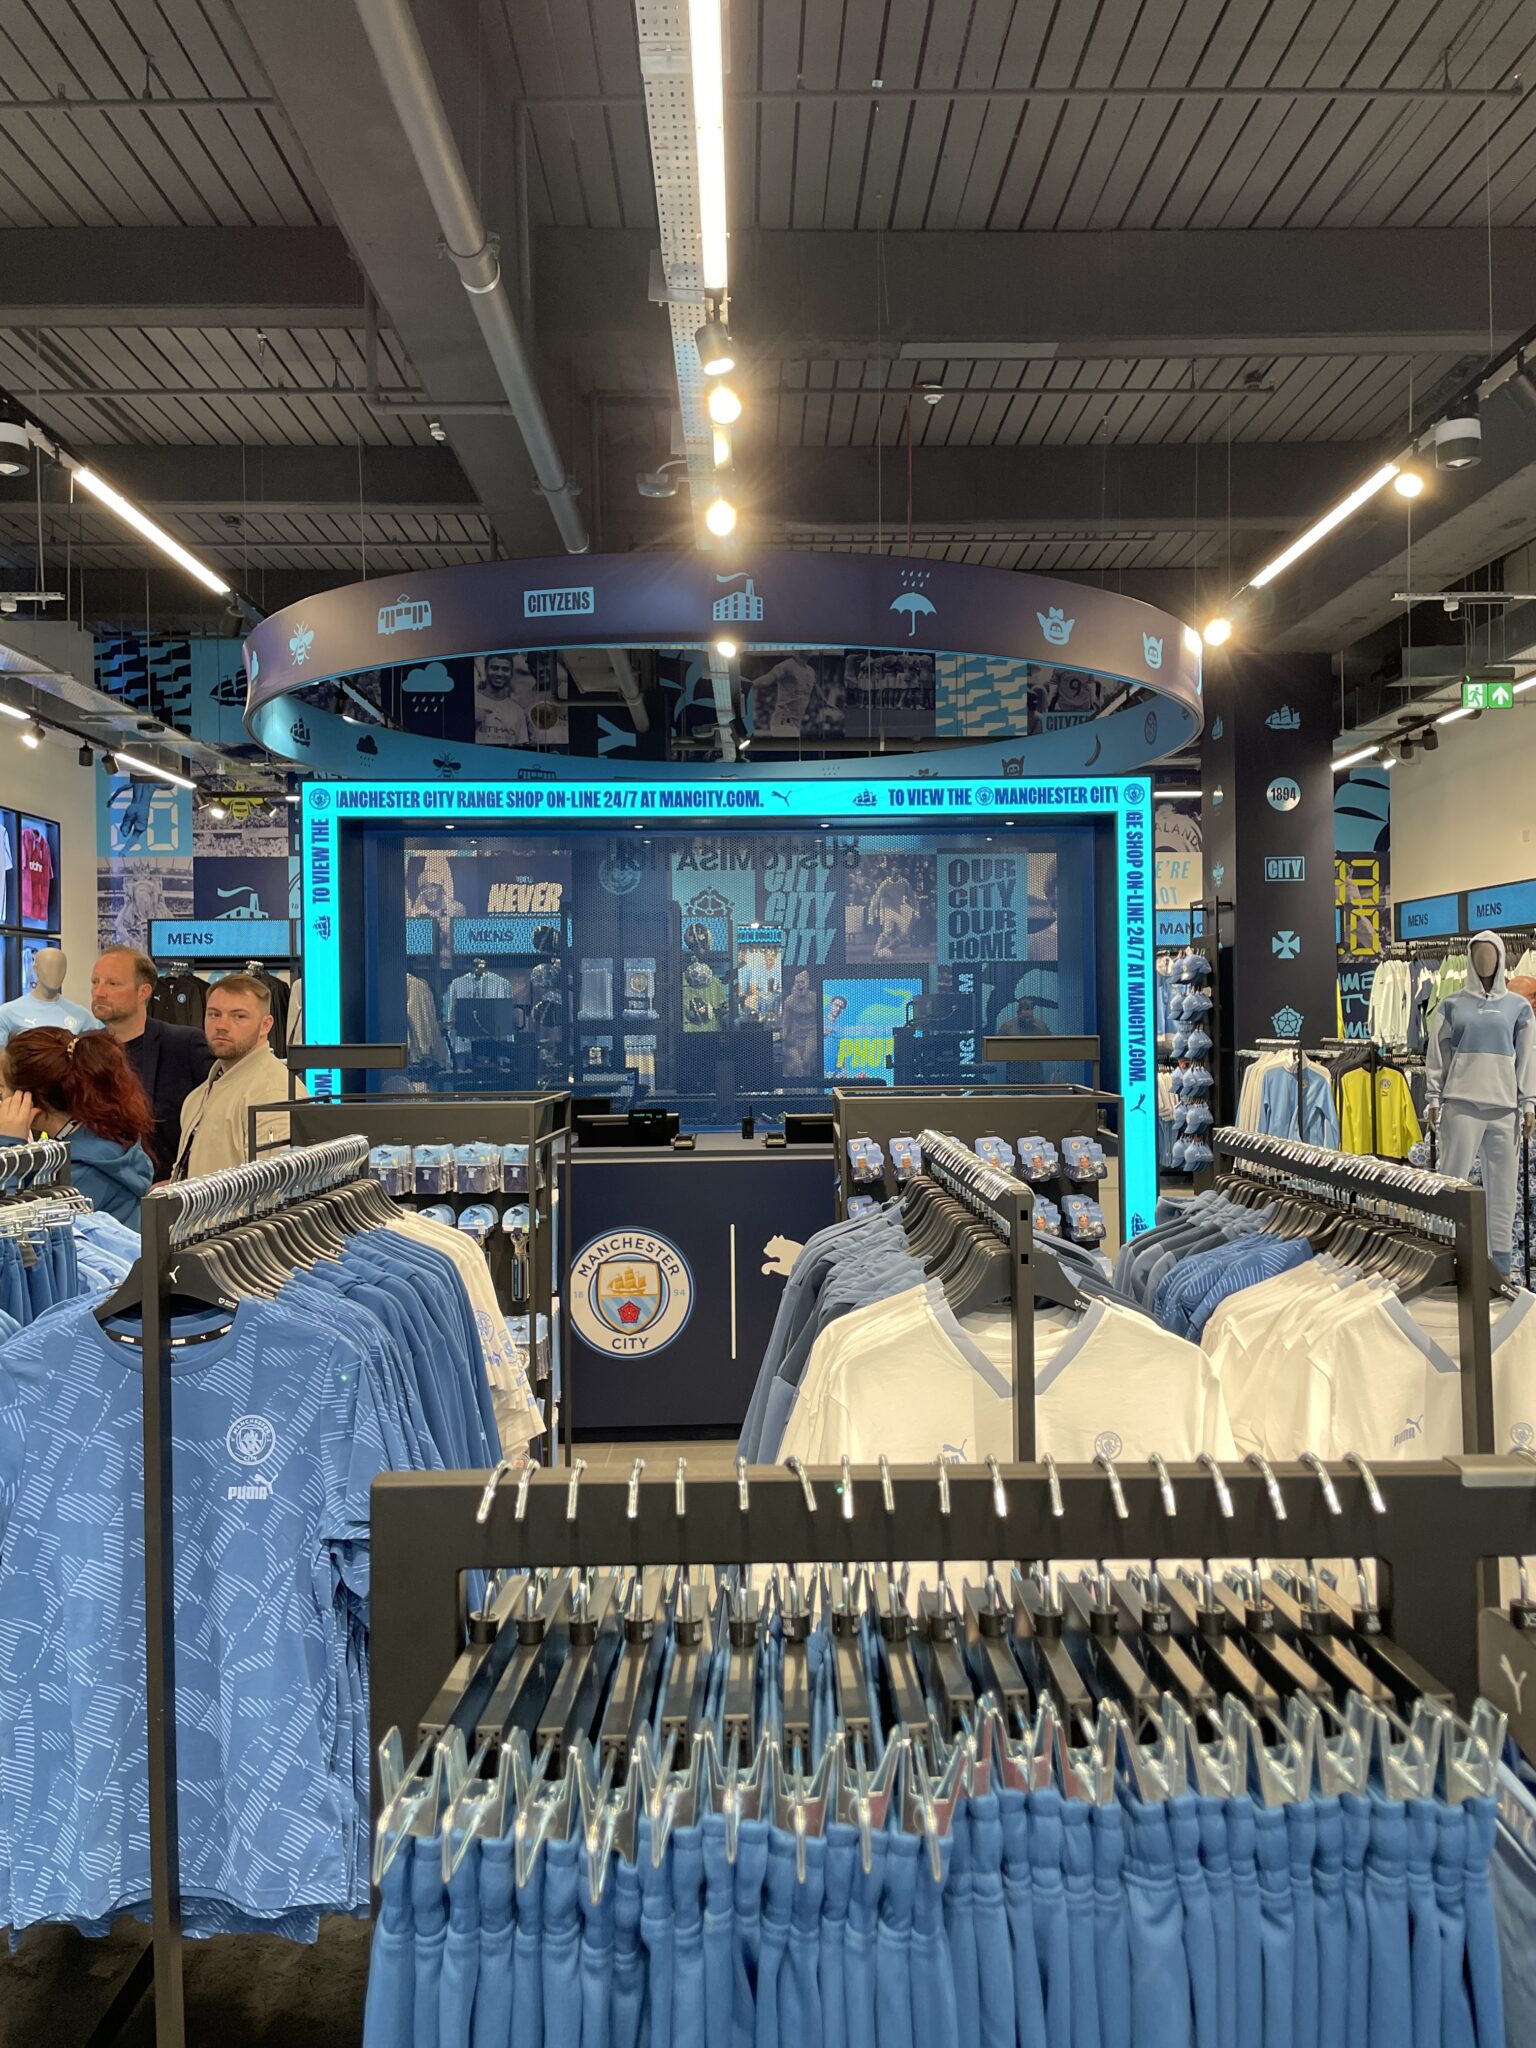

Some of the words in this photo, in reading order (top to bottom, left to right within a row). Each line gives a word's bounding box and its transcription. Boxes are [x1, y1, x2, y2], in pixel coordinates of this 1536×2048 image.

[528, 591, 590, 613] CITYZENS
[336, 790, 420, 808] ANCHESTER
[423, 790, 455, 808] CITY
[456, 790, 503, 808] RANGE
[506, 790, 544, 808] SHOP
[547, 790, 600, 808] ON-LINE
[603, 790, 638, 807] 24/7
[640, 790, 657, 807] AT
[888, 788, 903, 806] TO
[907, 788, 943, 806] VIEW
[947, 788, 972, 806] THE
[995, 786, 1087, 806] MANCHESTER
[1090, 785, 1118, 804] CITY
[1270, 788, 1296, 802] 1894
[311, 818, 330, 844] THE
[1126, 831, 1144, 868] SHOP
[312, 846, 330, 885] VIEW
[948, 859, 1016, 888] OUR
[1268, 860, 1301, 879] CITY
[312, 887, 331, 904] TO
[487, 882, 563, 912] NEVER
[948, 877, 1016, 908] CITY
[1126, 871, 1144, 924] ON-LINE
[1155, 886, 1177, 904] OT
[764, 891, 837, 928] CITY
[1475, 903, 1502, 918] MENS
[948, 910, 1016, 939] OUR
[1408, 914, 1429, 927] MENS
[168, 933, 214, 945] MENS
[467, 930, 514, 942] MENS
[948, 930, 1017, 959] HOME
[1127, 927, 1145, 961] 24/7
[781, 928, 837, 966] ITY
[1127, 963, 1145, 980] AT
[578, 1237, 680, 1278] MANCHESTER
[573, 1290, 584, 1299] 18
[673, 1288, 686, 1297] 94
[612, 1337, 649, 1350] CITY
[227, 1486, 269, 1500] PUMA
